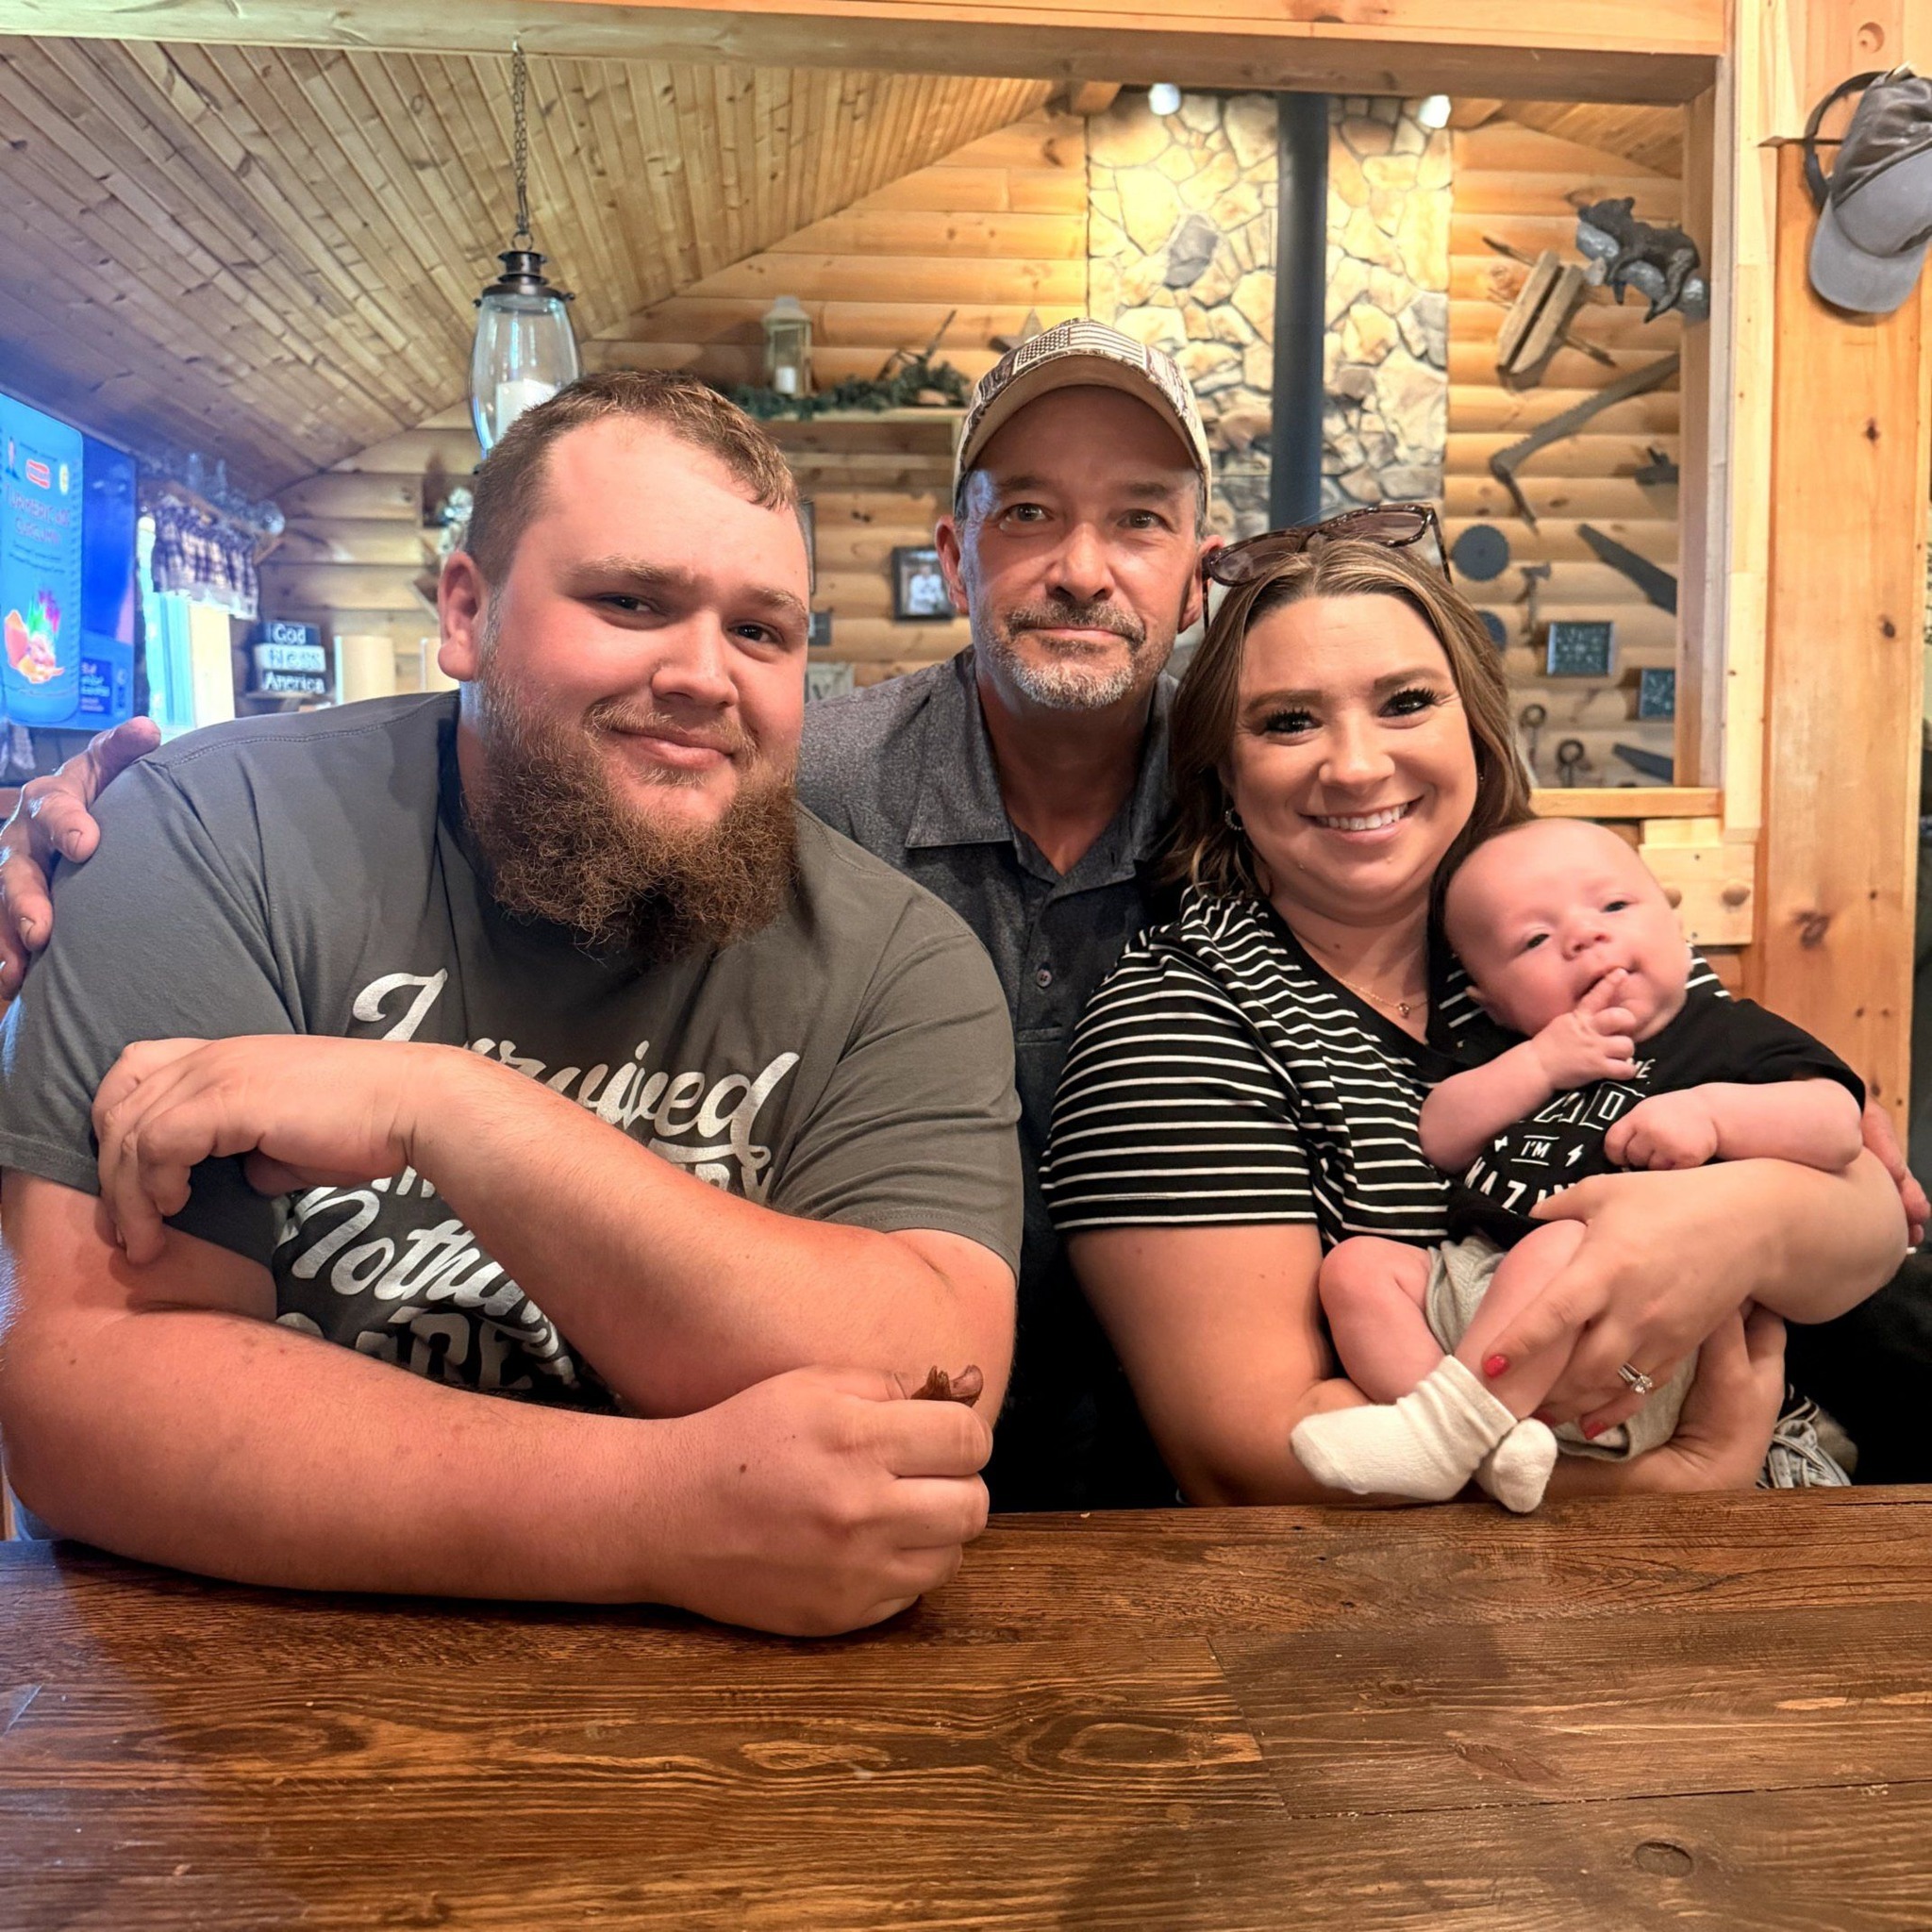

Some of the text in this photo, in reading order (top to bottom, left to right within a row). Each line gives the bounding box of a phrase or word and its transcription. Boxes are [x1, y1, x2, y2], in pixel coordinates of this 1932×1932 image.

[273, 624, 306, 645] God
[261, 671, 325, 694] America
[1521, 1141, 1551, 1158] I'M
